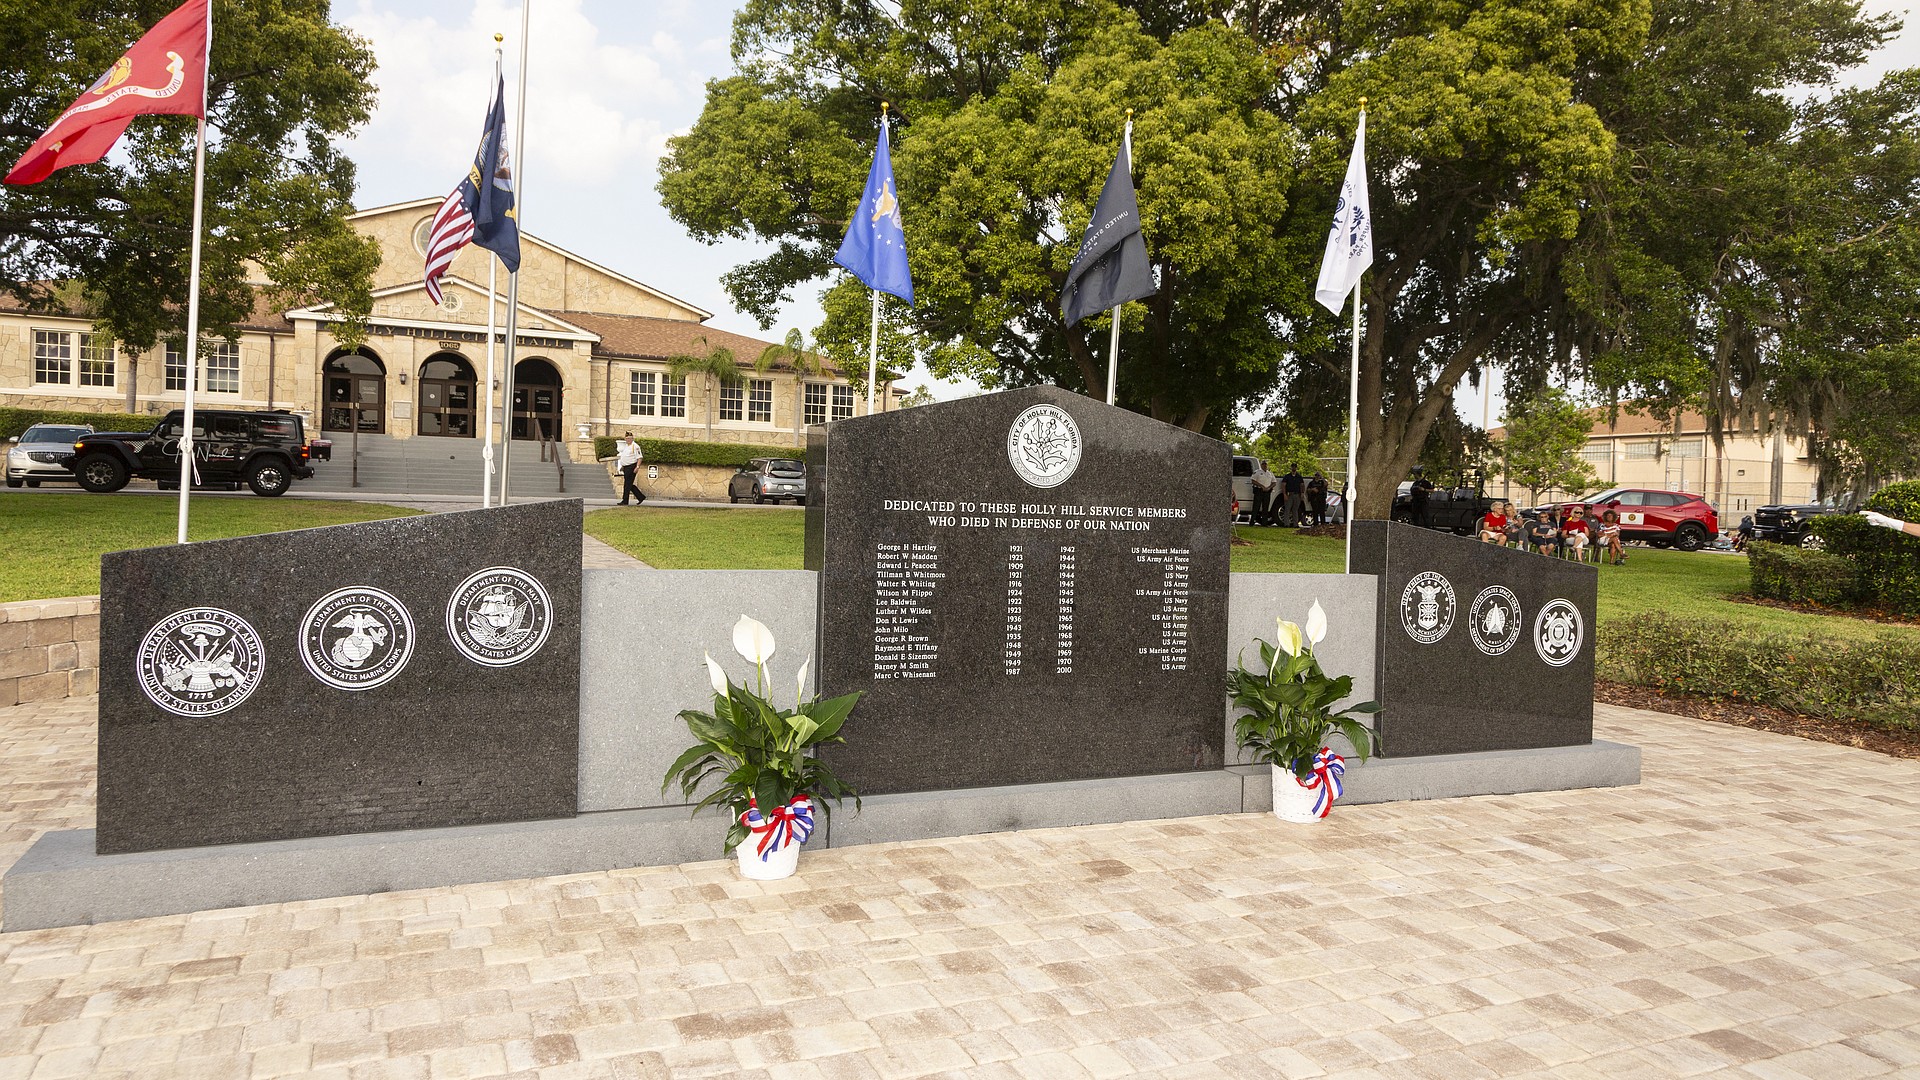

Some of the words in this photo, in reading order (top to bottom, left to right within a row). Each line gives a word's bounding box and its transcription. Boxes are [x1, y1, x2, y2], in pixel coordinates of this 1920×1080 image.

[406, 328, 452, 339] HILL
[516, 337, 564, 347] HALL
[1019, 418, 1026, 427] OF
[1027, 410, 1047, 419] HOLLY
[1050, 410, 1062, 420] HILL
[1064, 419, 1077, 449] FLORIDA
[884, 500, 955, 511] DEDICATED
[959, 502, 975, 512] TO
[980, 503, 1016, 513] THESE
[1022, 504, 1056, 515] HOLLY
[1061, 506, 1086, 515] HILL
[1090, 506, 1133, 516] SERVICE
[1138, 508, 1186, 518] MEMBERS
[928, 516, 955, 526] WHO
[961, 518, 989, 527] DIED
[995, 518, 1007, 527] IN
[1012, 519, 1062, 529] DEFENSE
[1066, 520, 1080, 529] OF
[1084, 520, 1106, 529] OUR
[1110, 521, 1150, 530] NATION
[460, 576, 499, 606] DEPARTMENT
[514, 579, 528, 589] THE
[527, 588, 541, 606] NAVY
[314, 596, 357, 627] DEPARTMENT
[373, 598, 389, 610] THE
[387, 608, 402, 626] NAVY
[144, 613, 198, 659] DEPARTMENT
[224, 616, 243, 632] THE
[242, 631, 259, 656] ARMY
[460, 631, 480, 651] UNITED
[480, 649, 505, 657] STATES
[517, 630, 539, 652] AMERICA
[313, 649, 332, 672] UNITED
[332, 670, 357, 680] STATES
[360, 667, 386, 680] MARINE
[386, 648, 402, 668] CORPS
[145, 673, 170, 702] UNITED
[171, 700, 208, 712] STATES
[212, 700, 225, 710] OF
[228, 670, 257, 710] AMERICA
